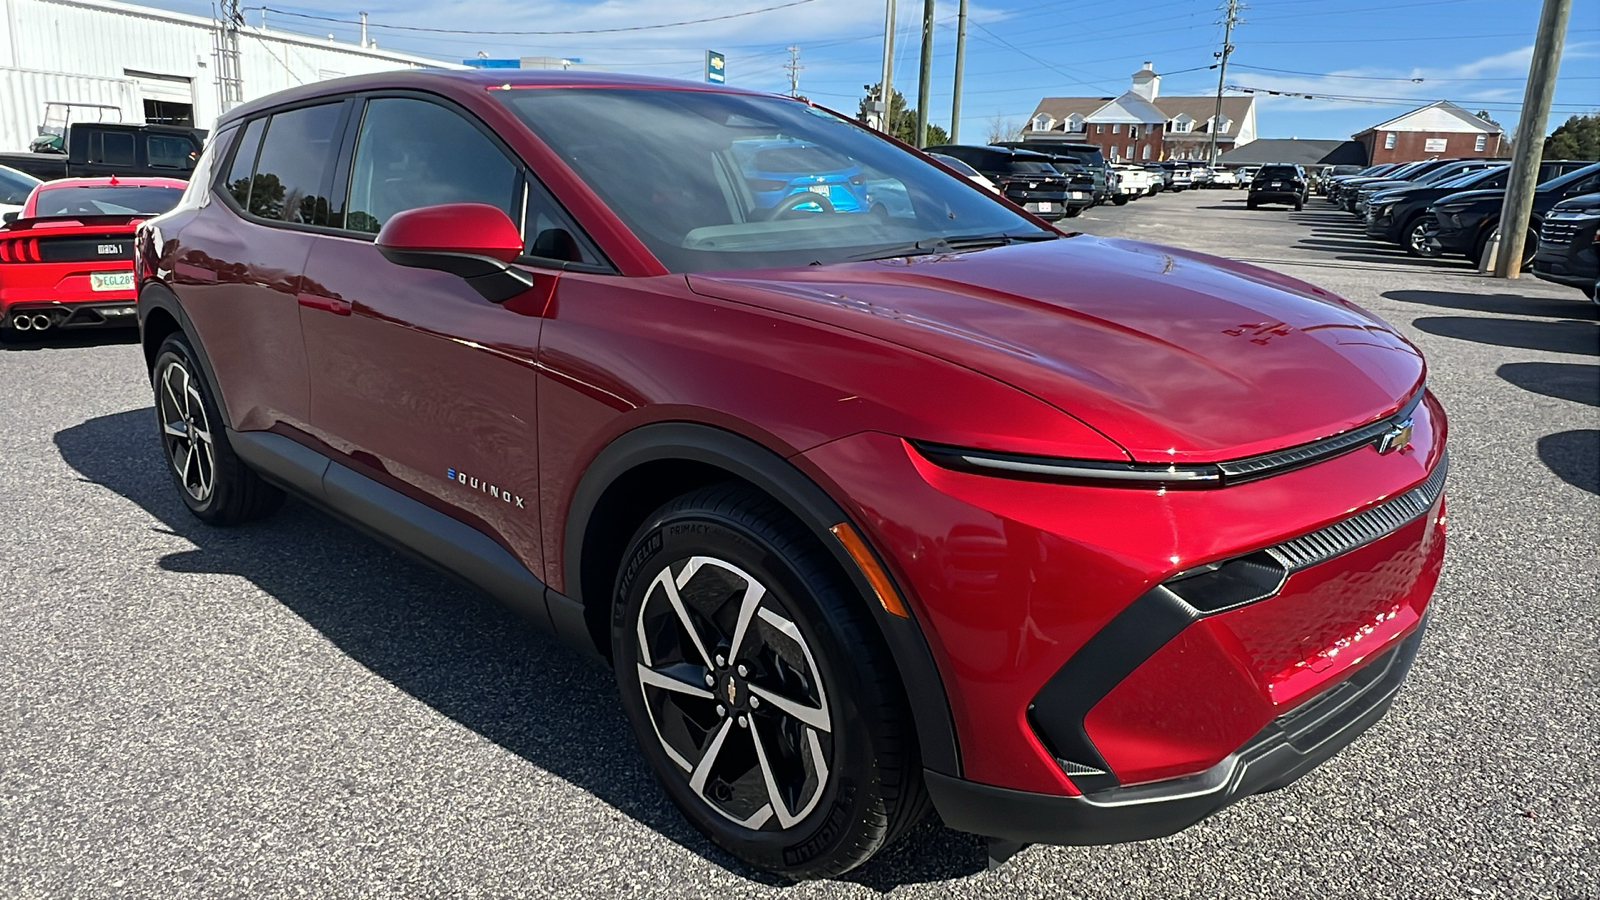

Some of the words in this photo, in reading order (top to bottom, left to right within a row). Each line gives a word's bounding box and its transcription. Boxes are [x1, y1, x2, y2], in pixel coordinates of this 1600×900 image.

[447, 467, 525, 509] EQUINOX
[670, 524, 710, 535] PRIMACY
[620, 533, 661, 600] MICHELIN
[785, 805, 847, 865] MICHELIN
